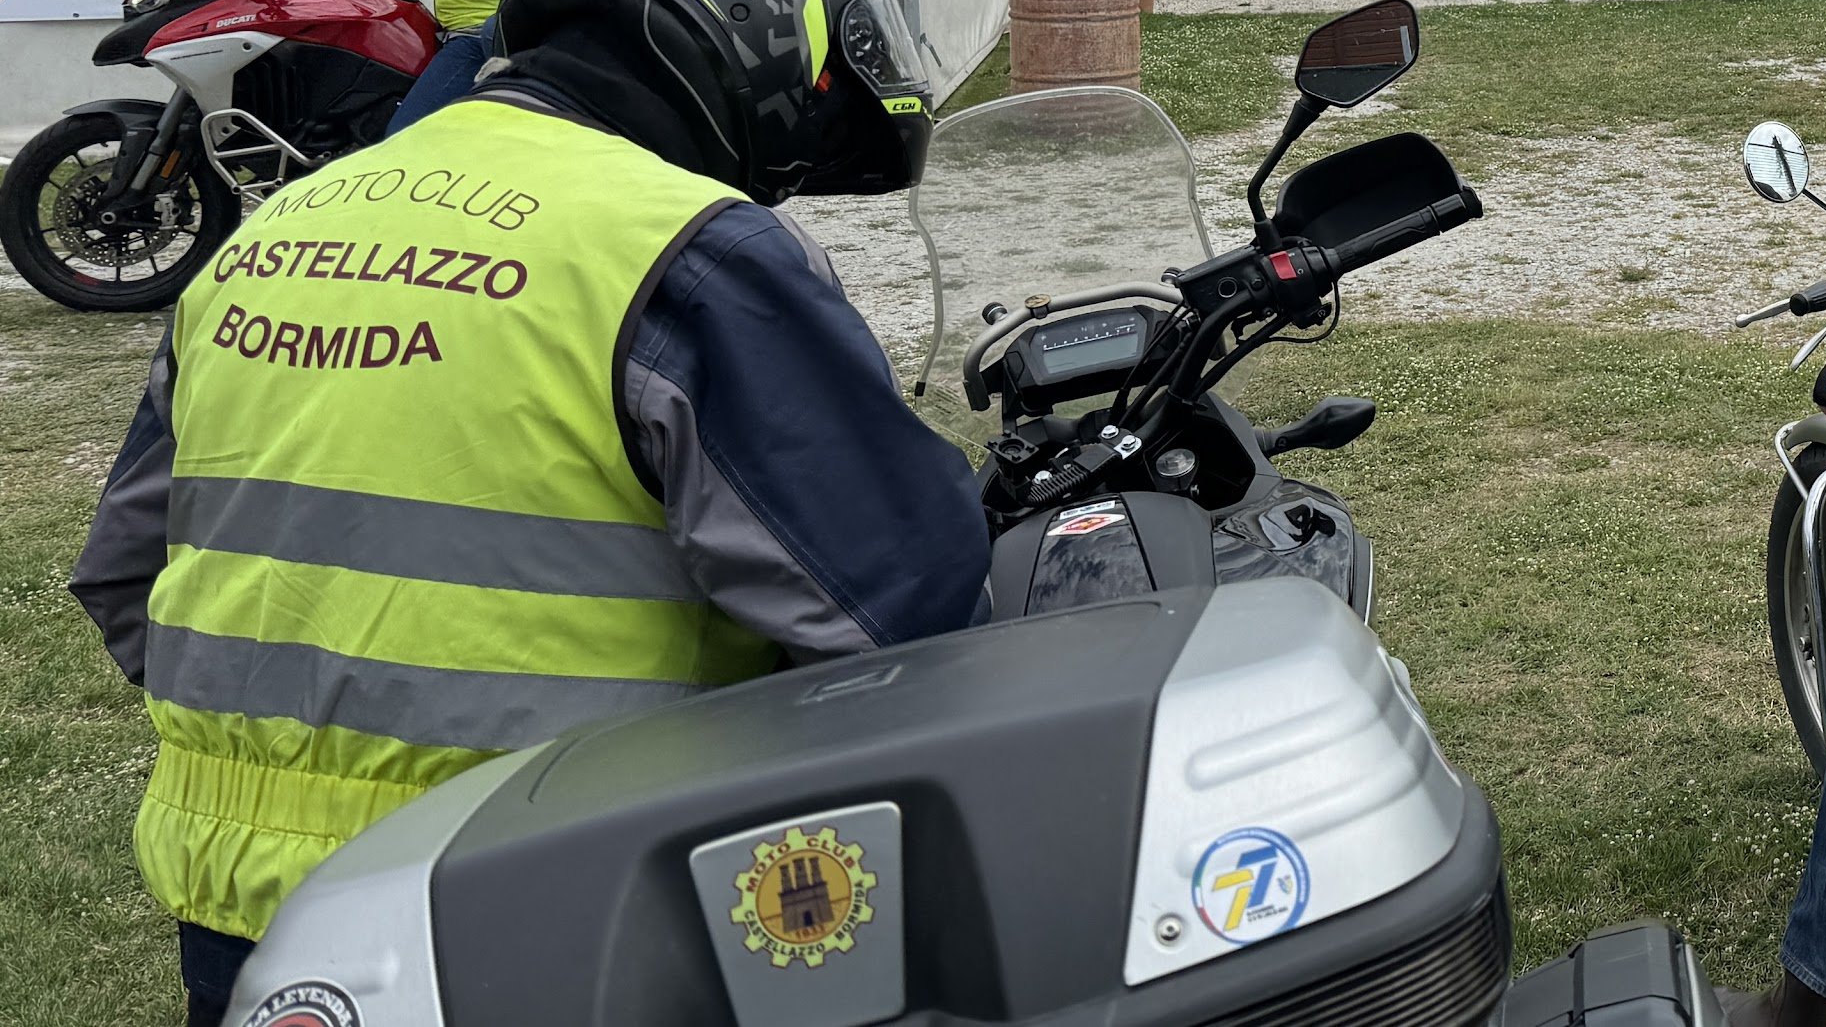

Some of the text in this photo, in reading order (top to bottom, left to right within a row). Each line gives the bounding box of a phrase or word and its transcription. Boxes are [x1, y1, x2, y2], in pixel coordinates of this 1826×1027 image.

[216, 14, 257, 28] DUCATI
[265, 168, 541, 231] MOTO CLUB
[213, 240, 528, 300] CASTELLAZZO
[213, 303, 443, 370] BORMIDA
[746, 837, 856, 893] MOTO CLUB
[744, 909, 826, 957] CASTELLAZZO
